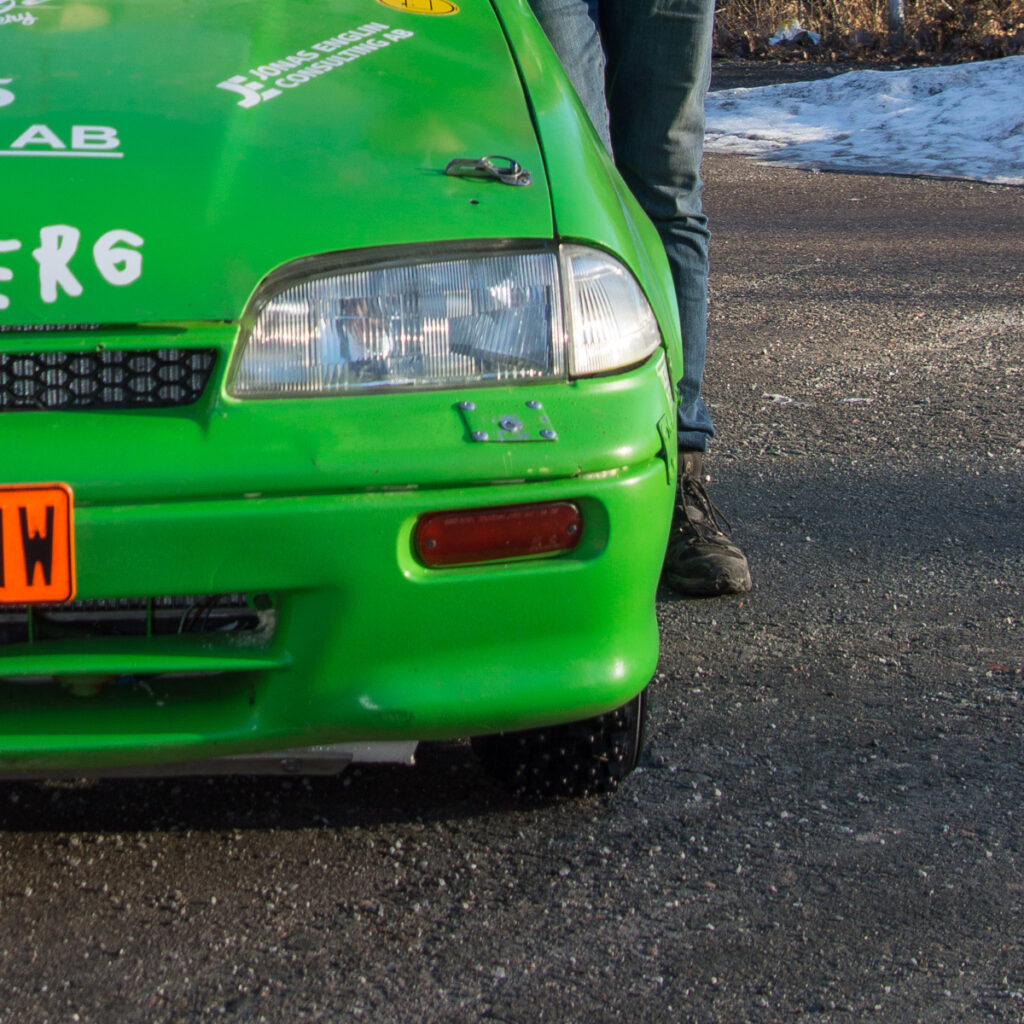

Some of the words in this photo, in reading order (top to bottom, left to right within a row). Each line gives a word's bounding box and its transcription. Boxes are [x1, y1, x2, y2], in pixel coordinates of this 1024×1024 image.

[249, 50, 319, 81] JONAS
[311, 21, 390, 53] ENGLIN
[275, 38, 390, 88] CONSULTING
[382, 29, 414, 43] AB
[10, 124, 121, 150] AB
